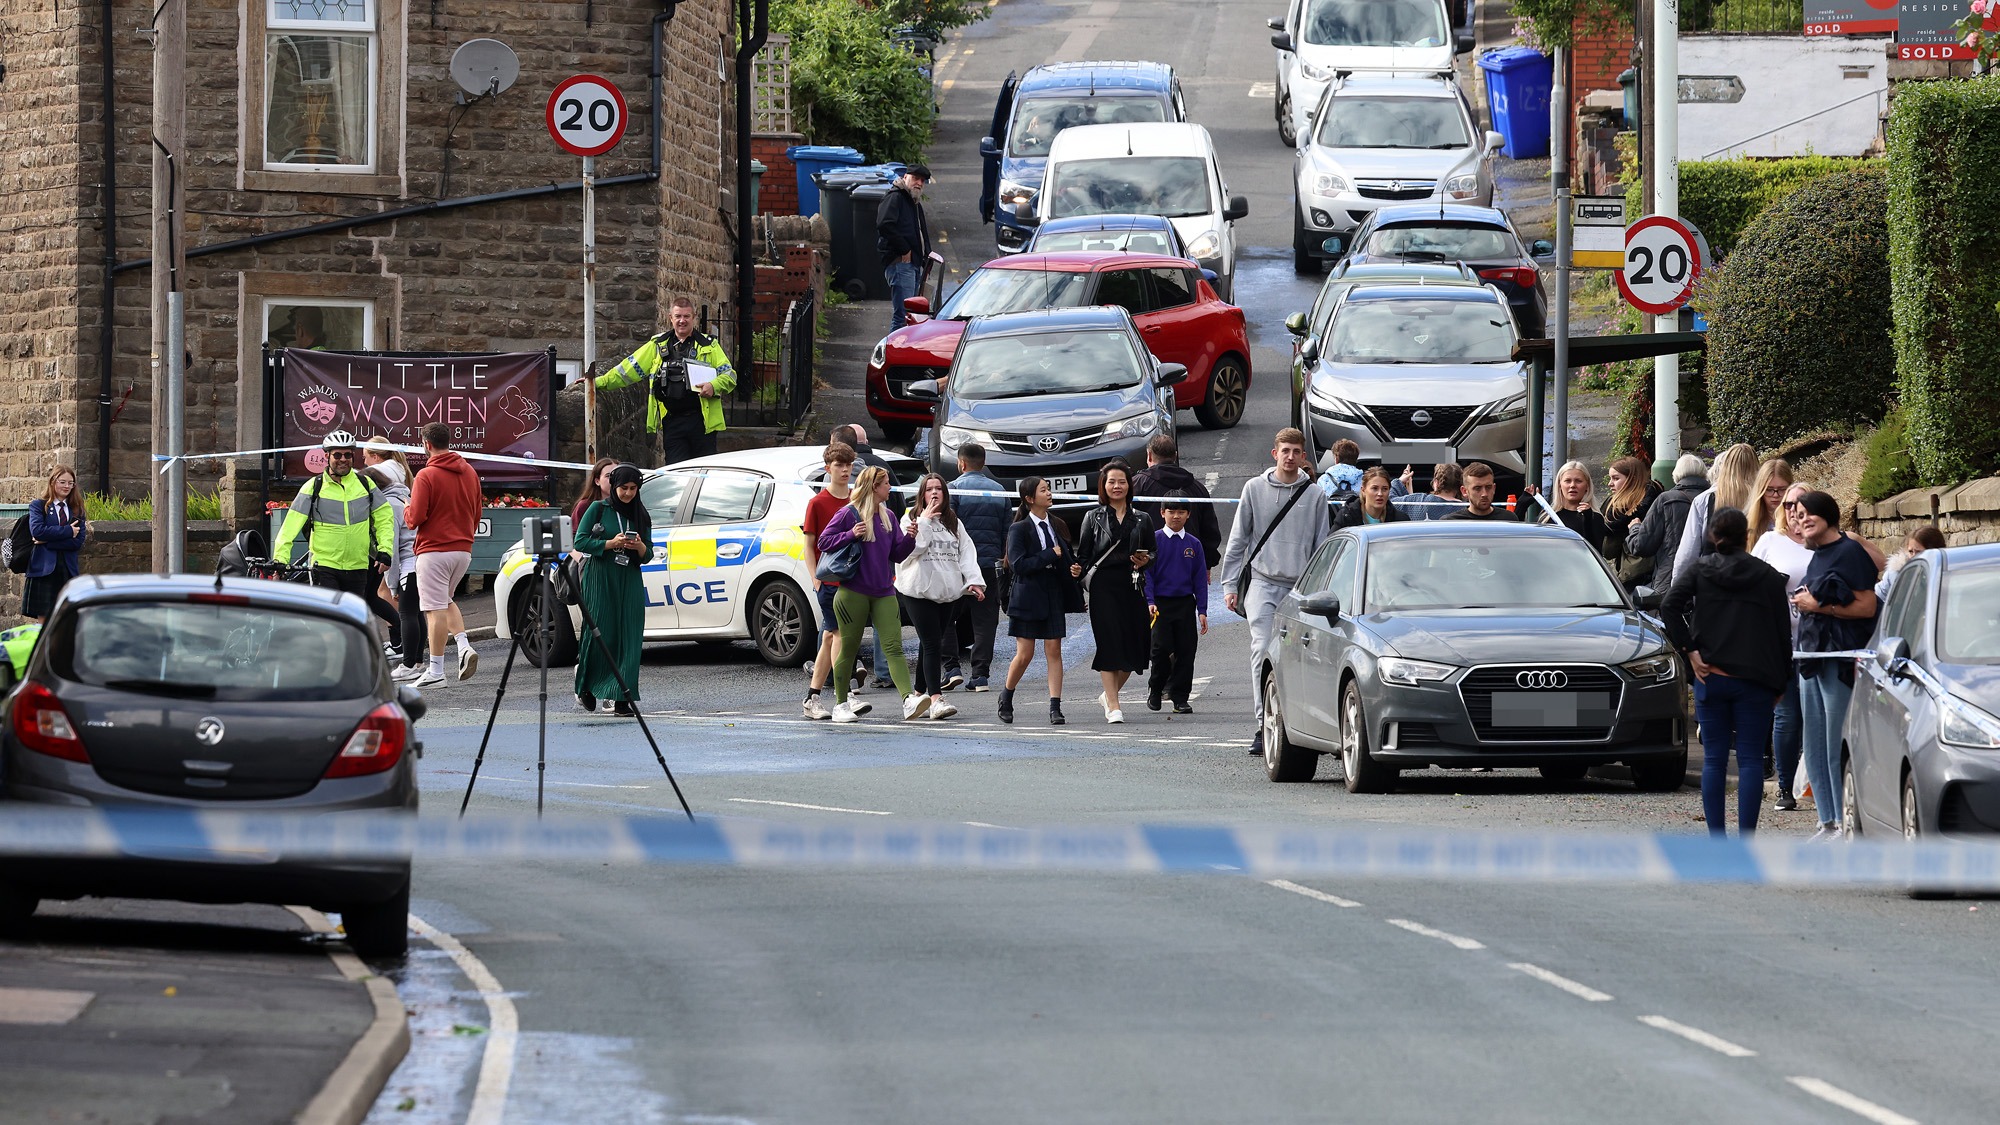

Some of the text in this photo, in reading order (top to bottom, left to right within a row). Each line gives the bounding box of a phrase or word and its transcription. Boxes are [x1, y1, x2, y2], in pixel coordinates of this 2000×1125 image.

[1901, 4, 1958, 12] RESIDE
[1806, 24, 1841, 34] SOLD
[1902, 47, 1953, 58] SOLD
[1519, 85, 1549, 112] 127
[560, 98, 615, 132] 20
[1628, 244, 1688, 285] 20
[348, 363, 489, 390] LITTLE
[297, 384, 339, 400] WAMDS
[347, 395, 488, 424] WOMEN
[352, 425, 486, 439] JULY 4T 8TH
[1055, 477, 1079, 490] PFY
[644, 580, 729, 607] LICE
